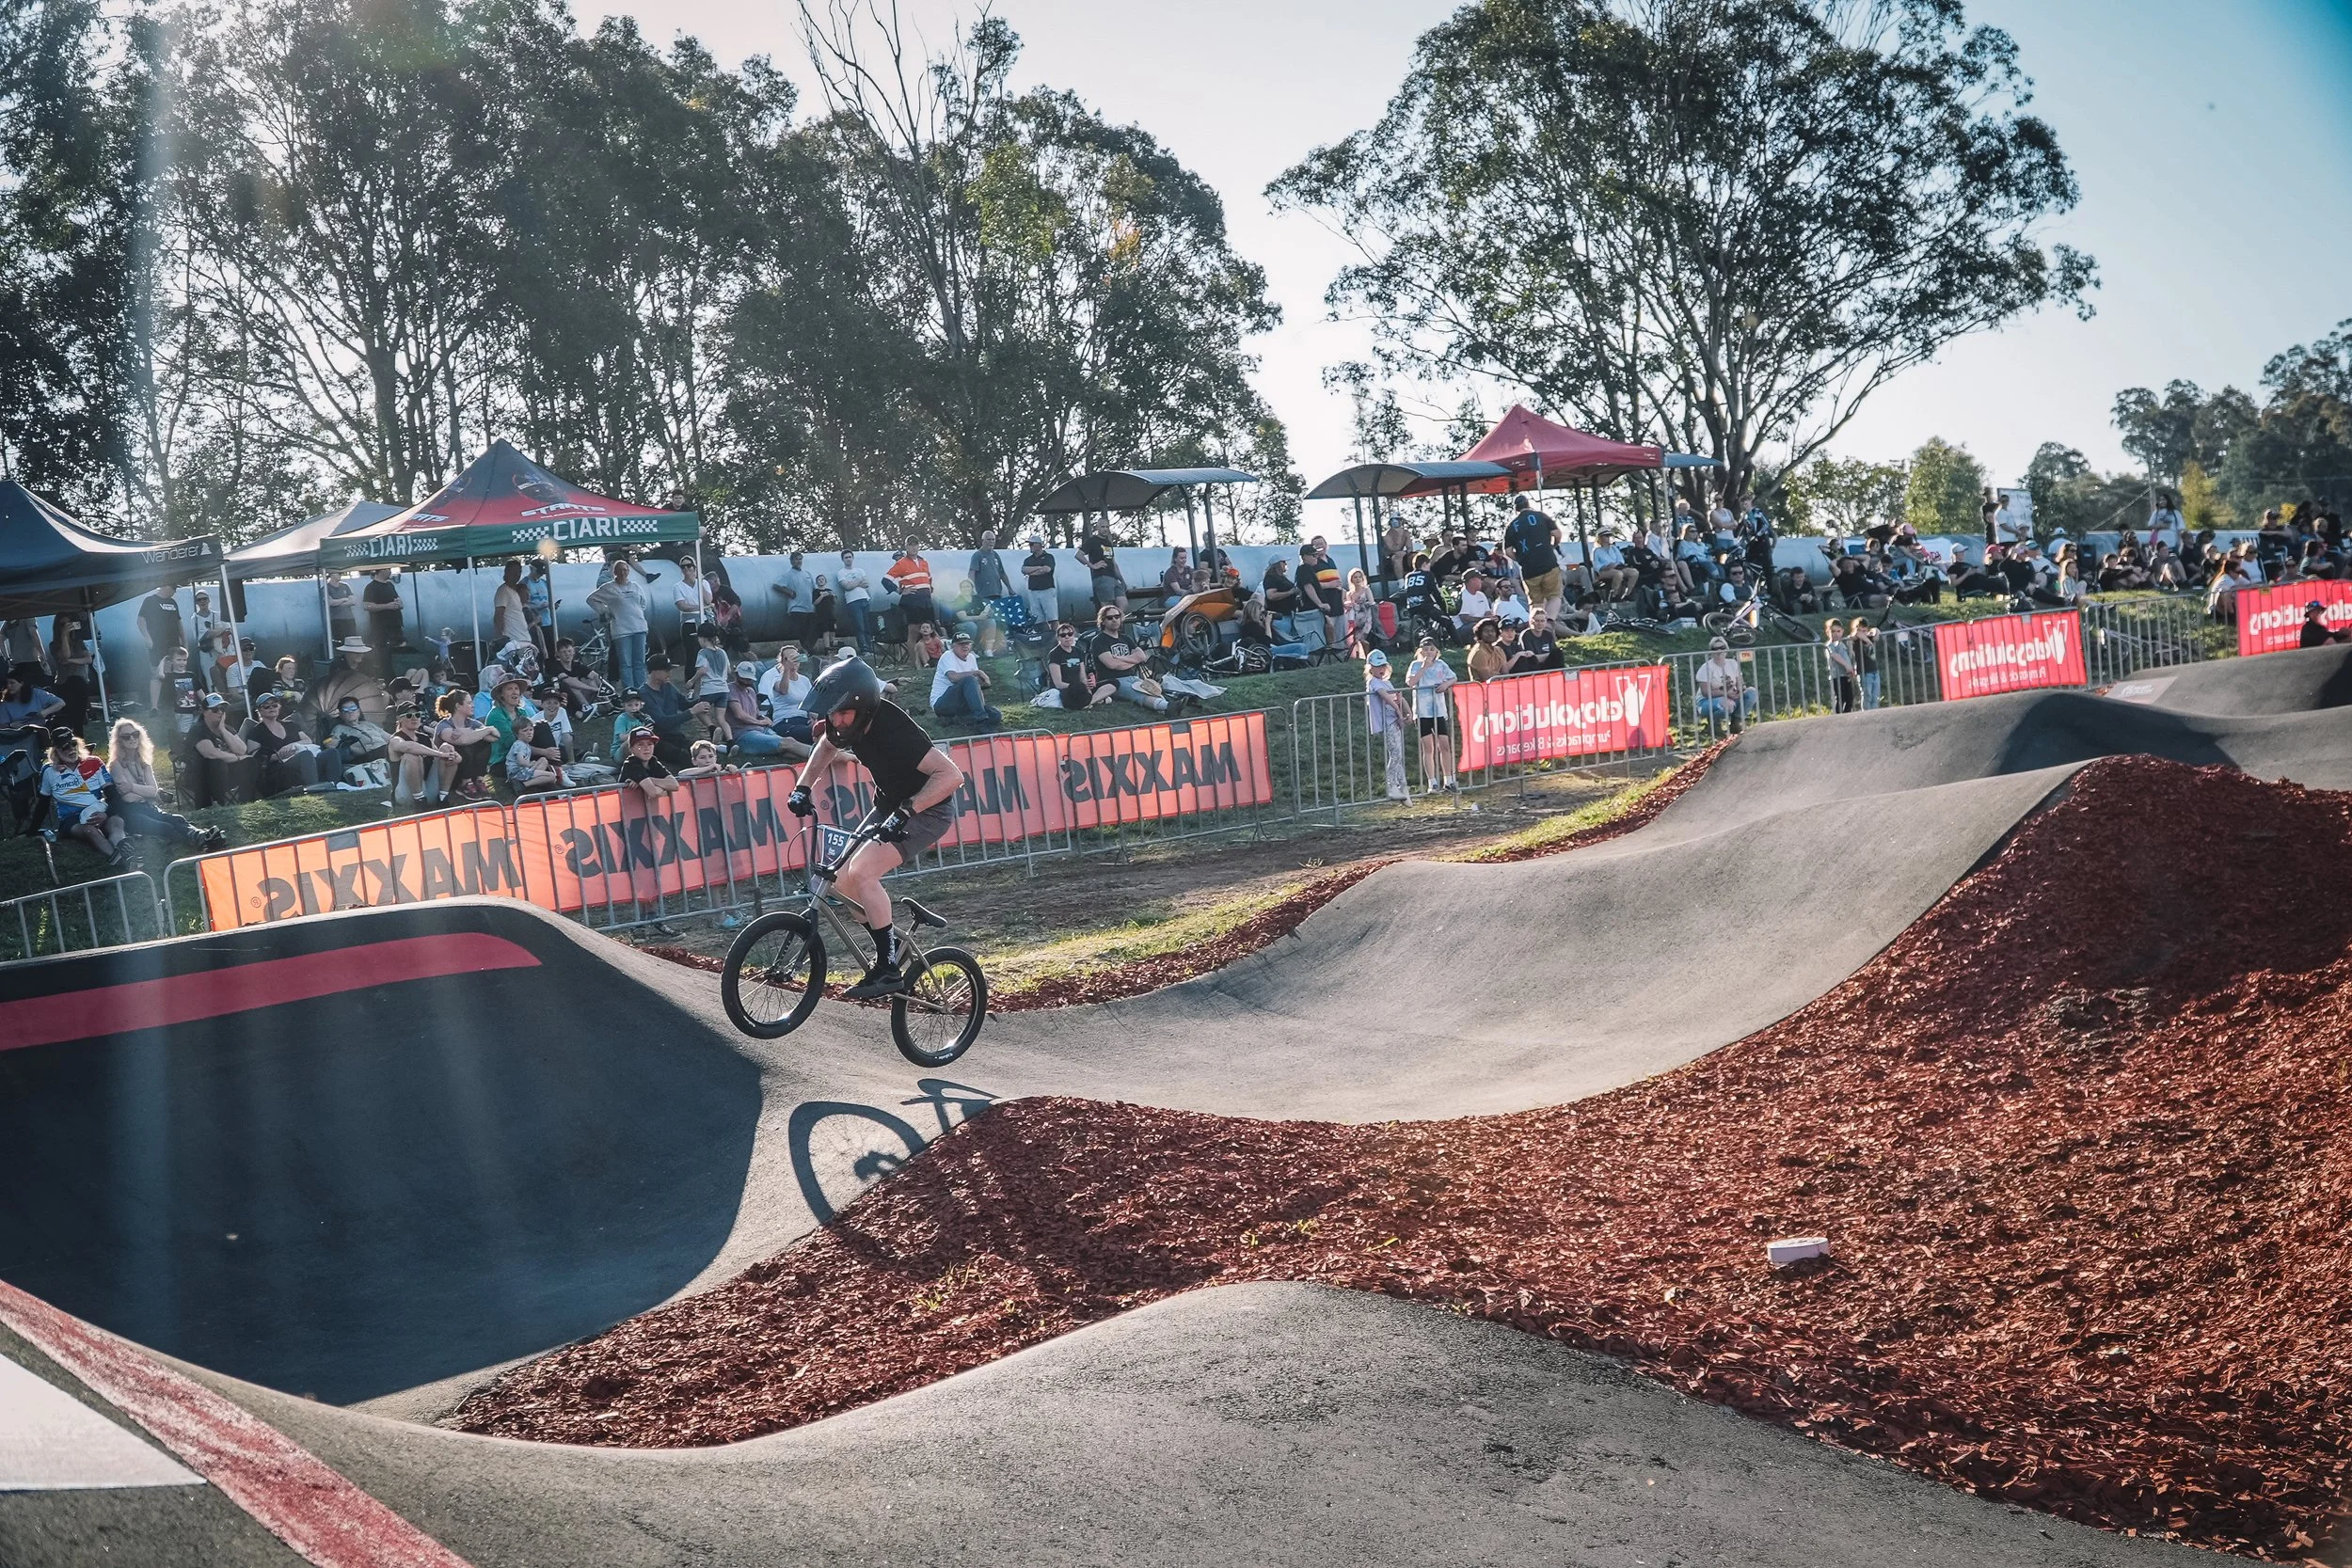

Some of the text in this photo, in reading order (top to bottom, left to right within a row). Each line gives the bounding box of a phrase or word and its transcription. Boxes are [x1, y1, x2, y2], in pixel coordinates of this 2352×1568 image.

[552, 516, 621, 541] CIARI
[141, 545, 199, 564] Wanderer
[368, 534, 413, 558] CIARI
[827, 832, 845, 847] 155
